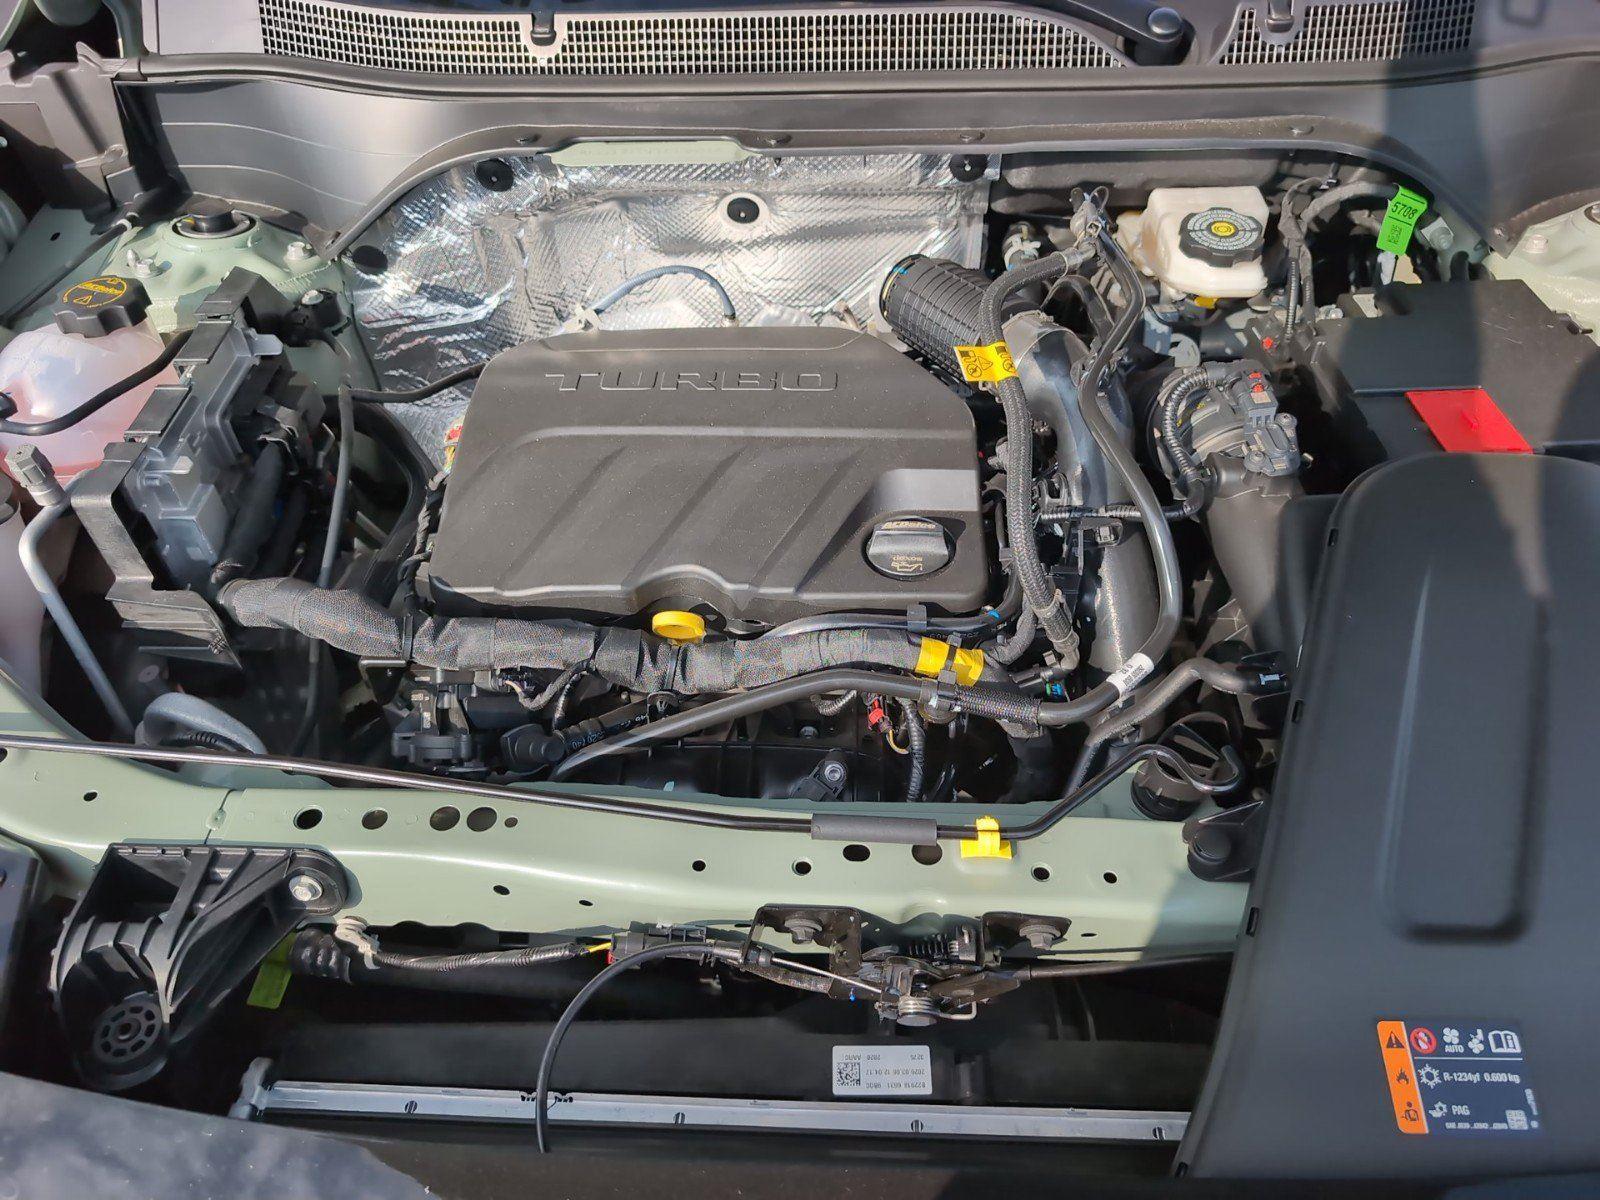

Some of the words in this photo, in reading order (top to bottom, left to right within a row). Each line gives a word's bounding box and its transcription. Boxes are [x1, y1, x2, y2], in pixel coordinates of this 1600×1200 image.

[1391, 201, 1418, 219] 5708
[545, 370, 838, 392] TURBO
[1444, 1044, 1465, 1053] AUTO
[1443, 1072, 1481, 1084] R-1234yf
[1483, 1072, 1508, 1083] 0.600
[1508, 1072, 1521, 1084] kg
[1451, 1104, 1471, 1116] PAG
